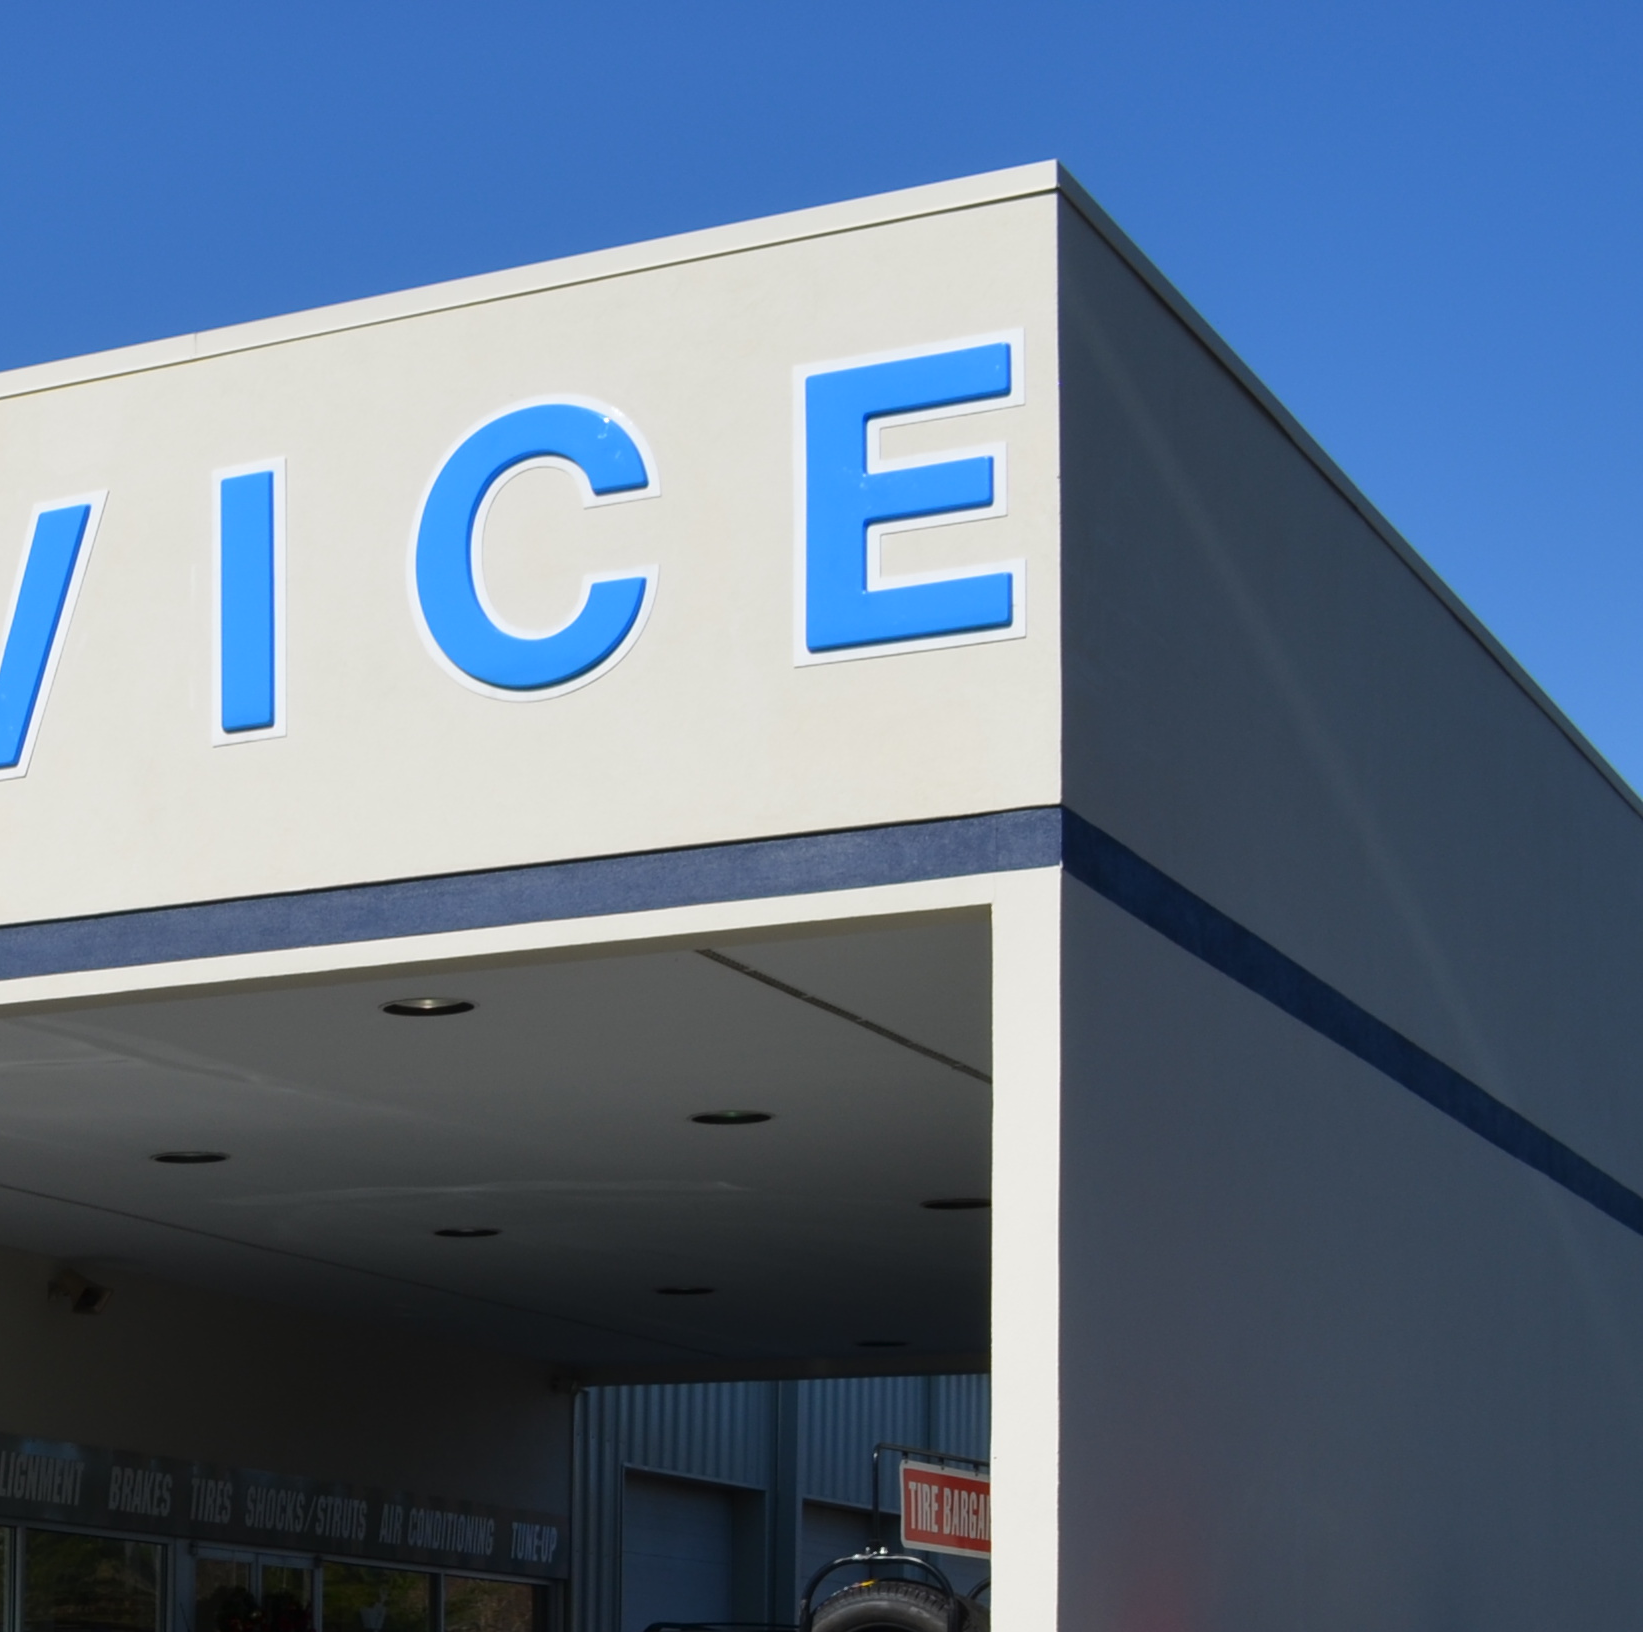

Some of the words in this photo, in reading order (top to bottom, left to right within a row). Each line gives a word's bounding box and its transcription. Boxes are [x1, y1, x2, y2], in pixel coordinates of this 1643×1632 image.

[108, 1466, 173, 1517] BRAKES
[190, 1478, 233, 1524] TIRES
[245, 1486, 367, 1541] SHOCKS/STRUTS
[379, 1503, 403, 1544] AIR
[407, 1508, 495, 1555] CONDITIONING
[511, 1521, 558, 1564] TUNE-UP
[908, 1481, 939, 1533] TIRE
